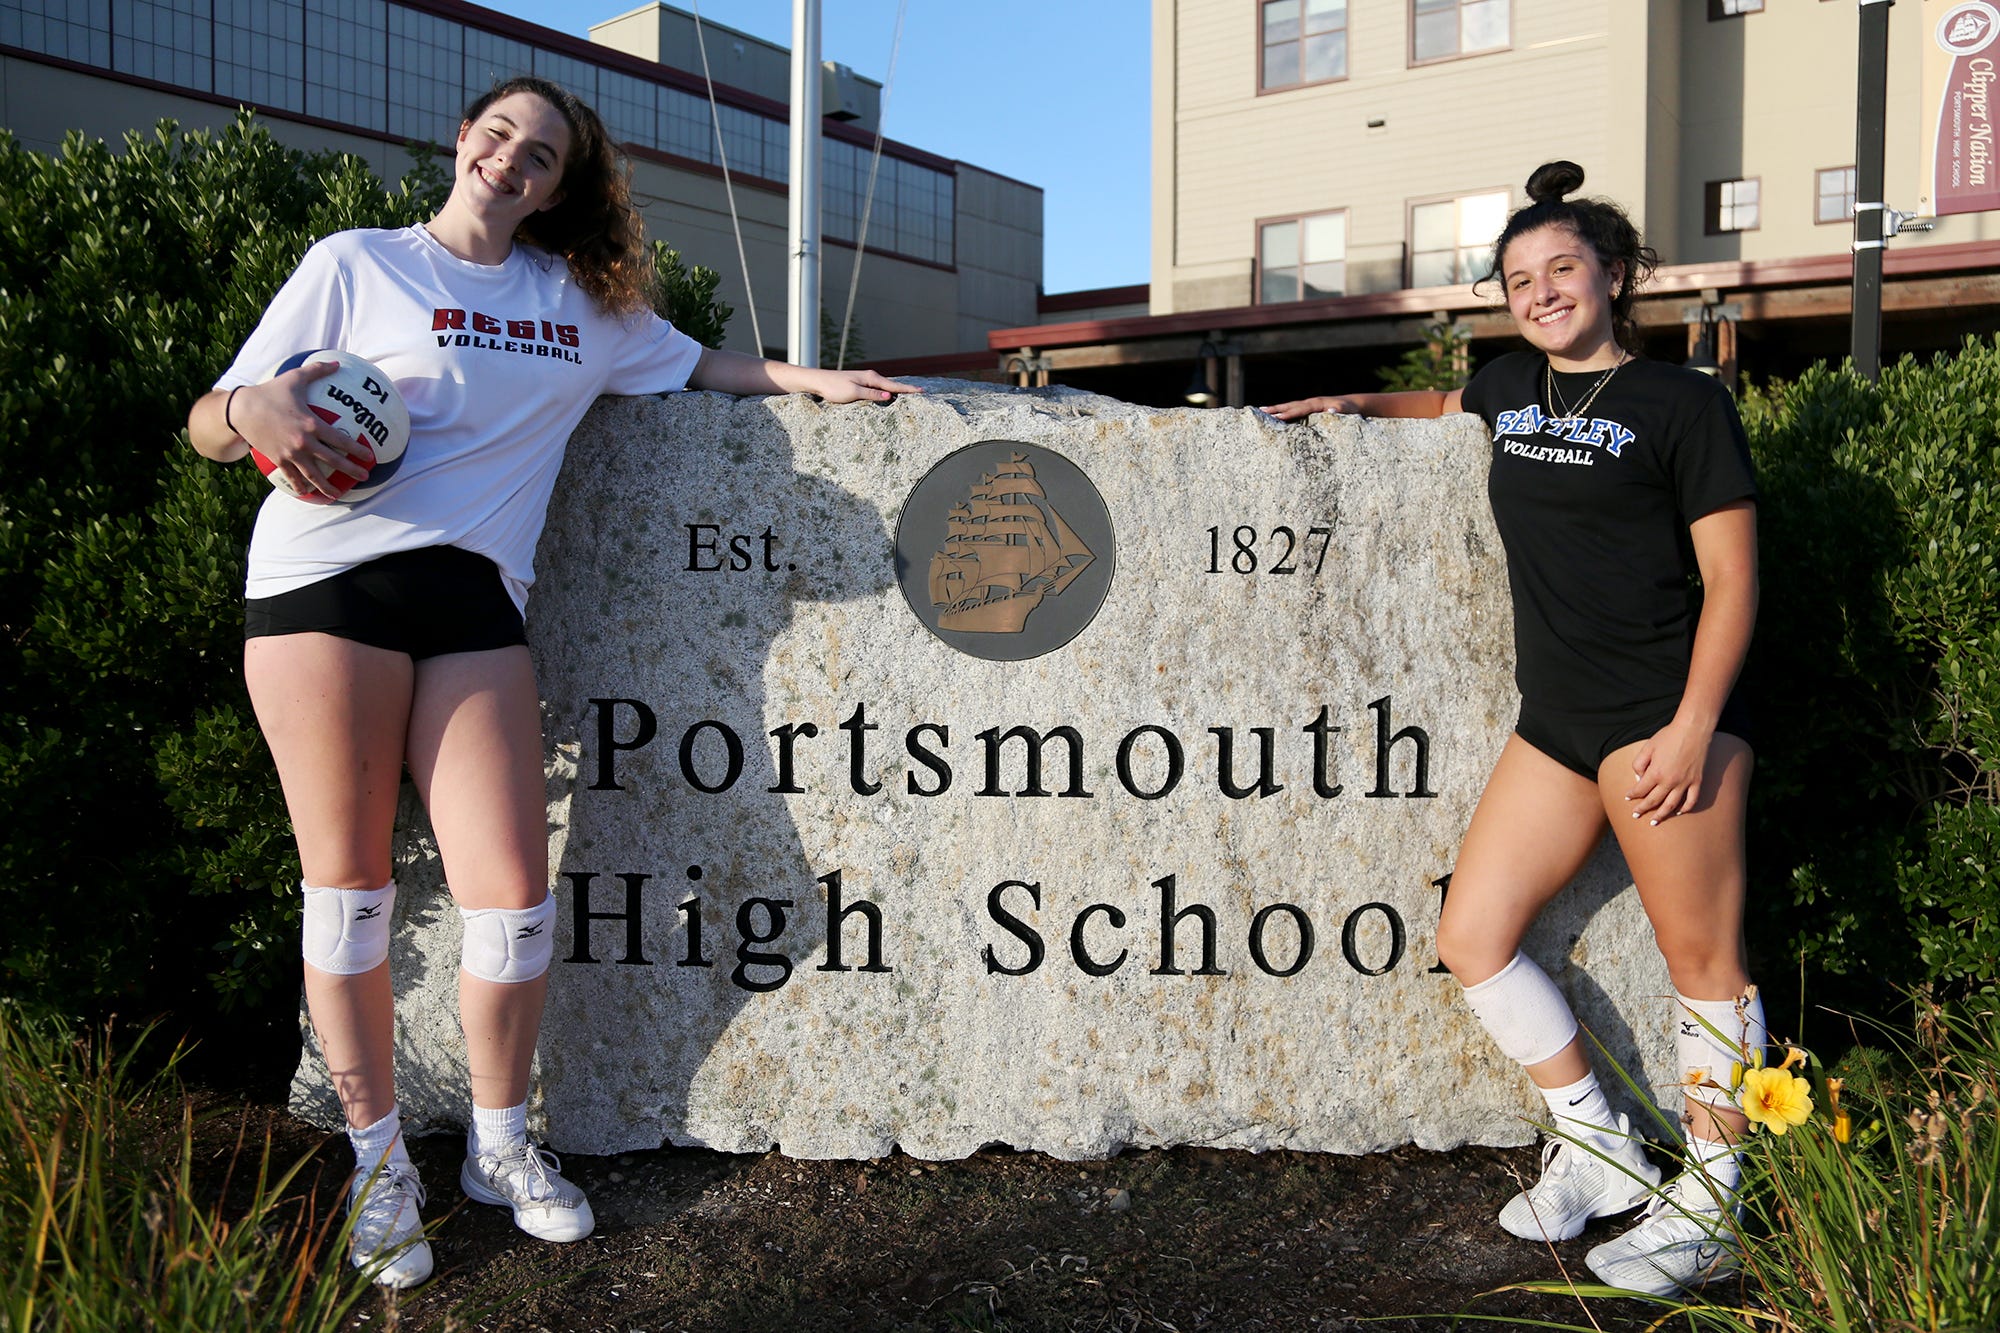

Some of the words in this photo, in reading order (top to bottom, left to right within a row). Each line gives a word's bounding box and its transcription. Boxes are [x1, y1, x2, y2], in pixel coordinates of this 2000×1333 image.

[1952, 91, 1961, 137] PORTSMOUTH
[1963, 57, 1996, 120] Clipper
[1952, 140, 1961, 157] HIGH
[1968, 123, 1992, 187] Nation
[1951, 160, 1961, 189] SCHOOL
[432, 308, 580, 348] REGIS
[437, 334, 582, 365] VOLLEYBALL
[327, 384, 390, 447] Wilson
[1493, 404, 1636, 458] BENTLEY
[1503, 440, 1594, 466] VOLLEYBALL
[682, 523, 798, 574] Est.
[1203, 524, 1334, 576] 1827
[588, 695, 1439, 800] Portsmouth
[561, 865, 893, 993] High
